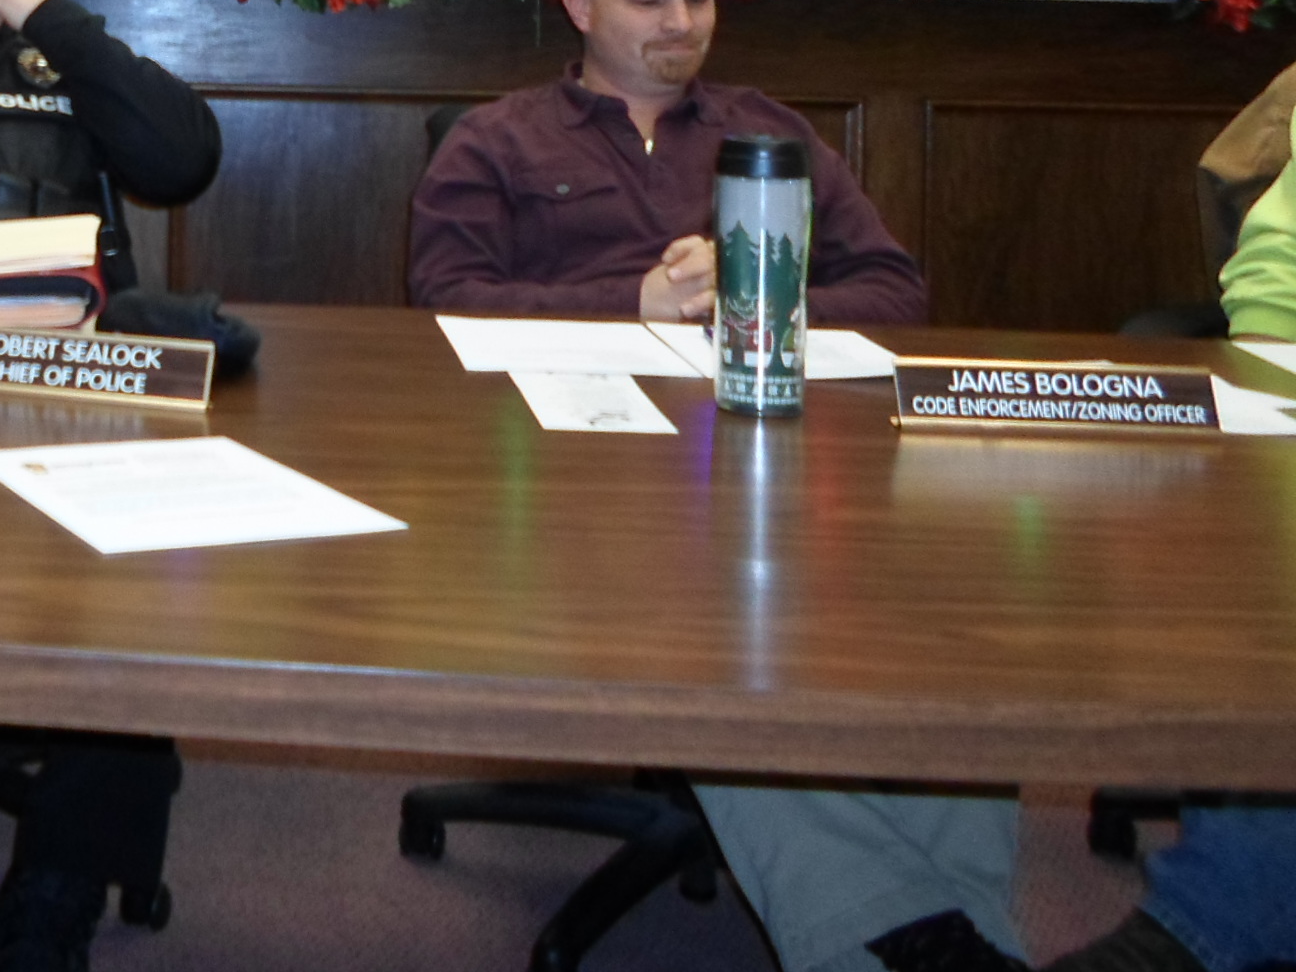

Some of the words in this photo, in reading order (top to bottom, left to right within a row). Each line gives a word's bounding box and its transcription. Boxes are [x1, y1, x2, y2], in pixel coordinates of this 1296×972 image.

[62, 340, 163, 370] SEALOCK
[44, 364, 73, 387] OF
[75, 369, 148, 394] POLICE
[947, 370, 1030, 395] JAMES
[1034, 372, 1164, 399] BOLOGNA
[912, 396, 956, 415] CODE
[960, 398, 1141, 421] ENFORCEMENT/ZONING
[1145, 403, 1207, 424] OFFICER
